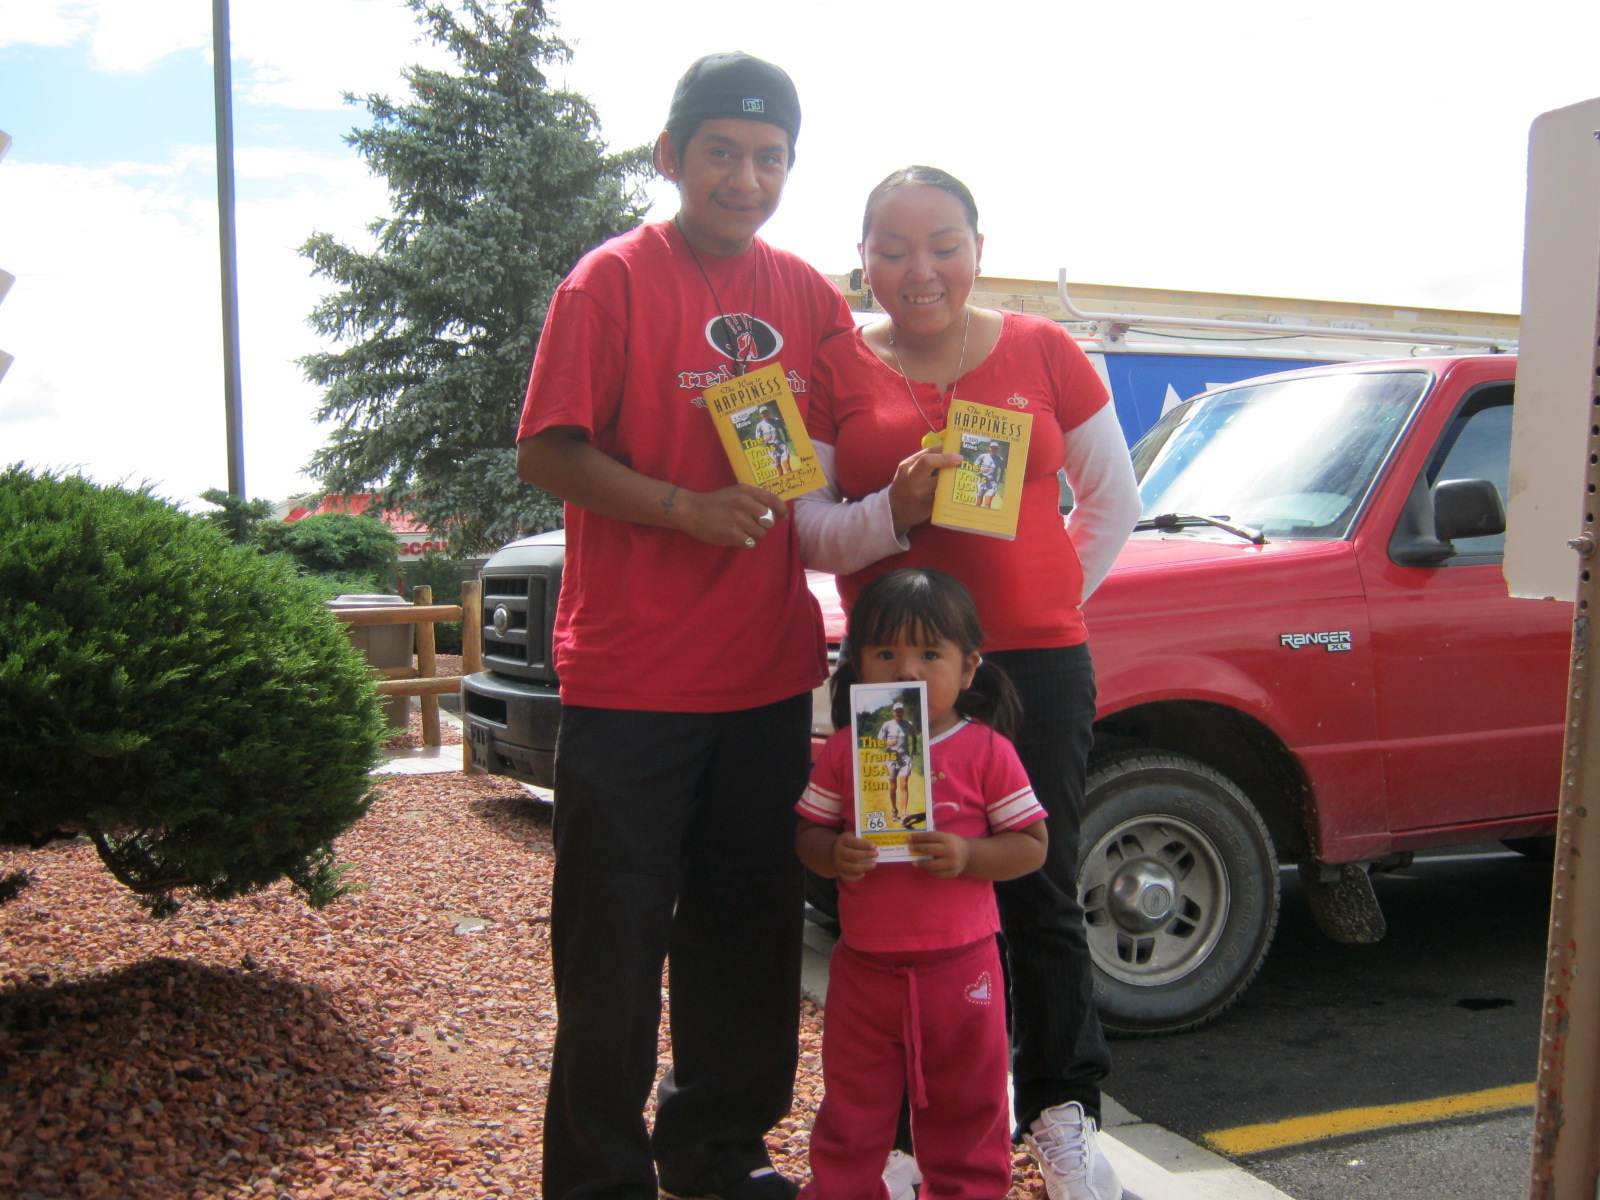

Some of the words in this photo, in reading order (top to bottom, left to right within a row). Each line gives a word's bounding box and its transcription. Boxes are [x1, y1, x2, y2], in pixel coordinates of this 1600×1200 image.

[713, 376, 781, 413] HAPPINESS
[954, 411, 1023, 438] HAPPINESS
[742, 437, 763, 449] The
[960, 460, 980, 472] The
[1280, 631, 1351, 649] RANGER
[860, 735, 886, 748] The
[861, 751, 897, 763] Trans
[863, 764, 889, 777] USA
[862, 780, 889, 792] Run
[870, 818, 885, 829] 66
